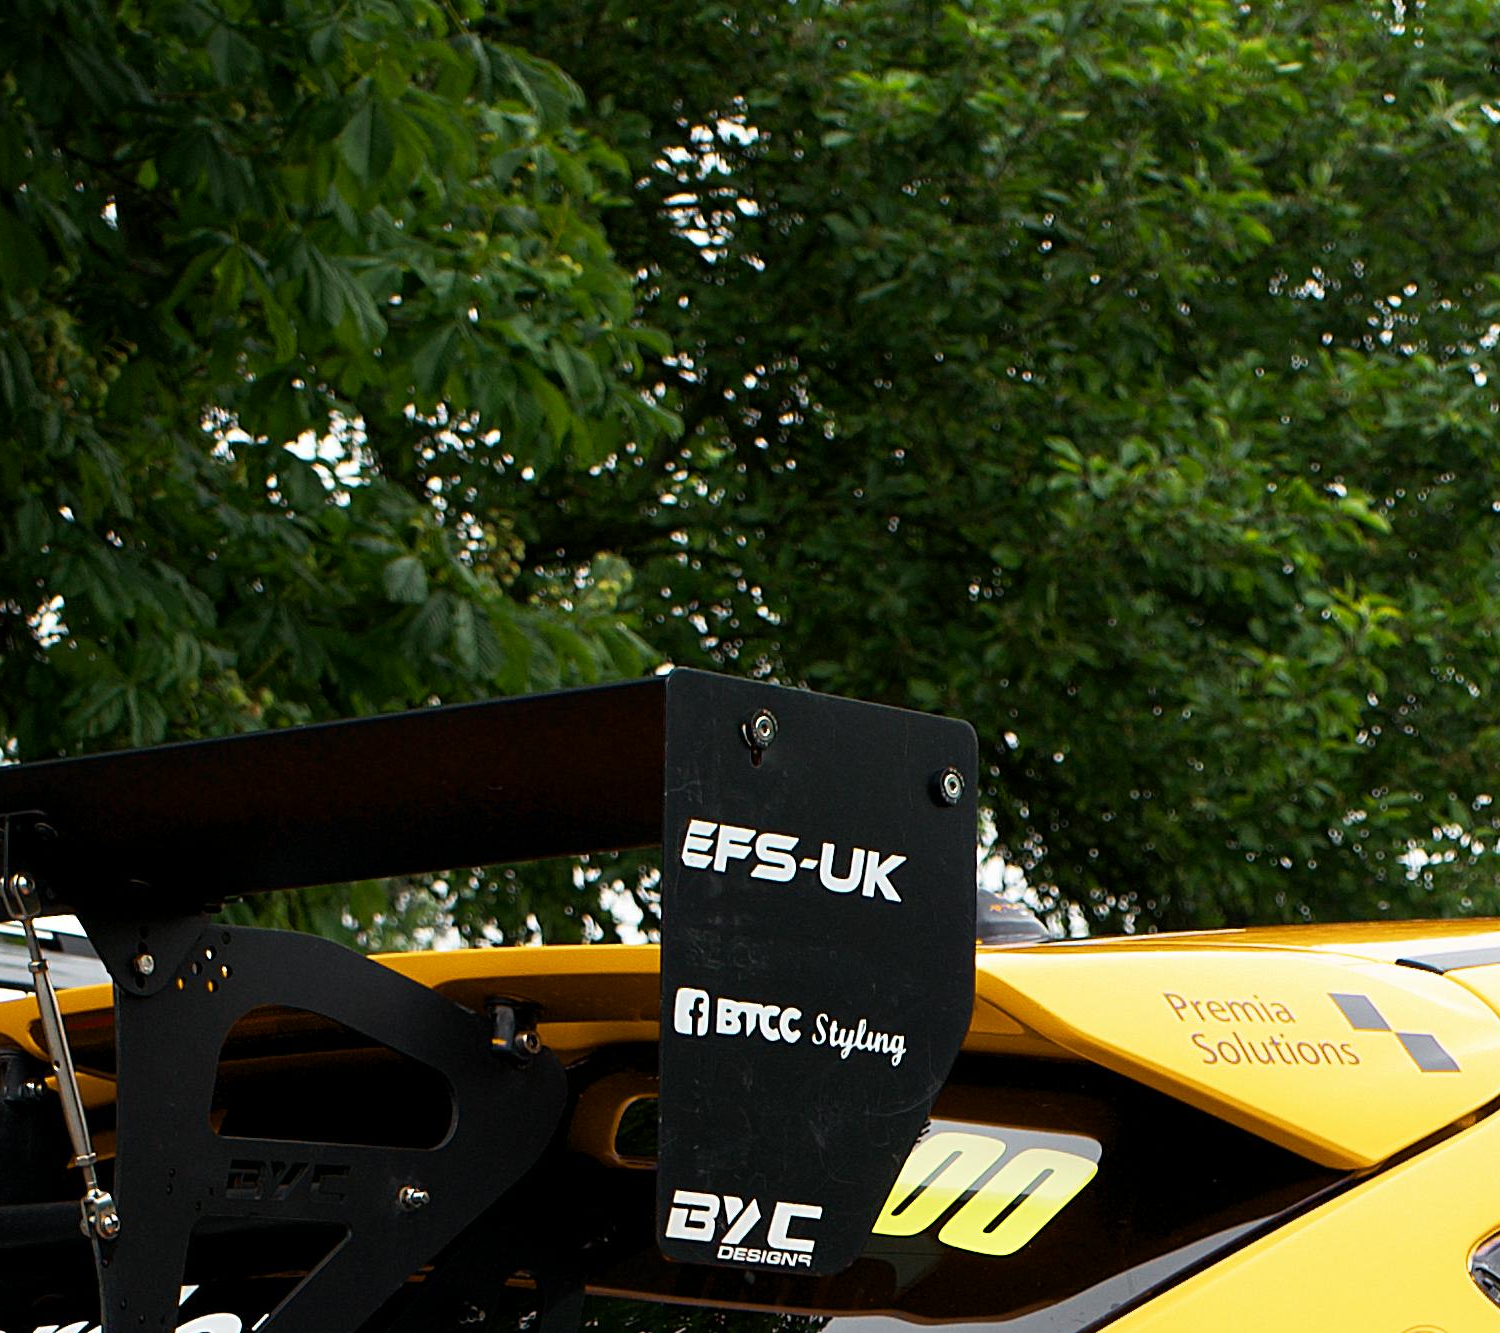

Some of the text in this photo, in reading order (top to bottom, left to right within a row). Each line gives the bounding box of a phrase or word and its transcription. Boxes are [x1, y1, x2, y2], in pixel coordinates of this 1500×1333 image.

[681, 819, 906, 902] EFS-UK
[716, 998, 802, 1044] BTCC
[810, 1012, 907, 1066] Styling
[1164, 991, 1297, 1025] Premia
[1191, 1031, 1361, 1068] Solutions
